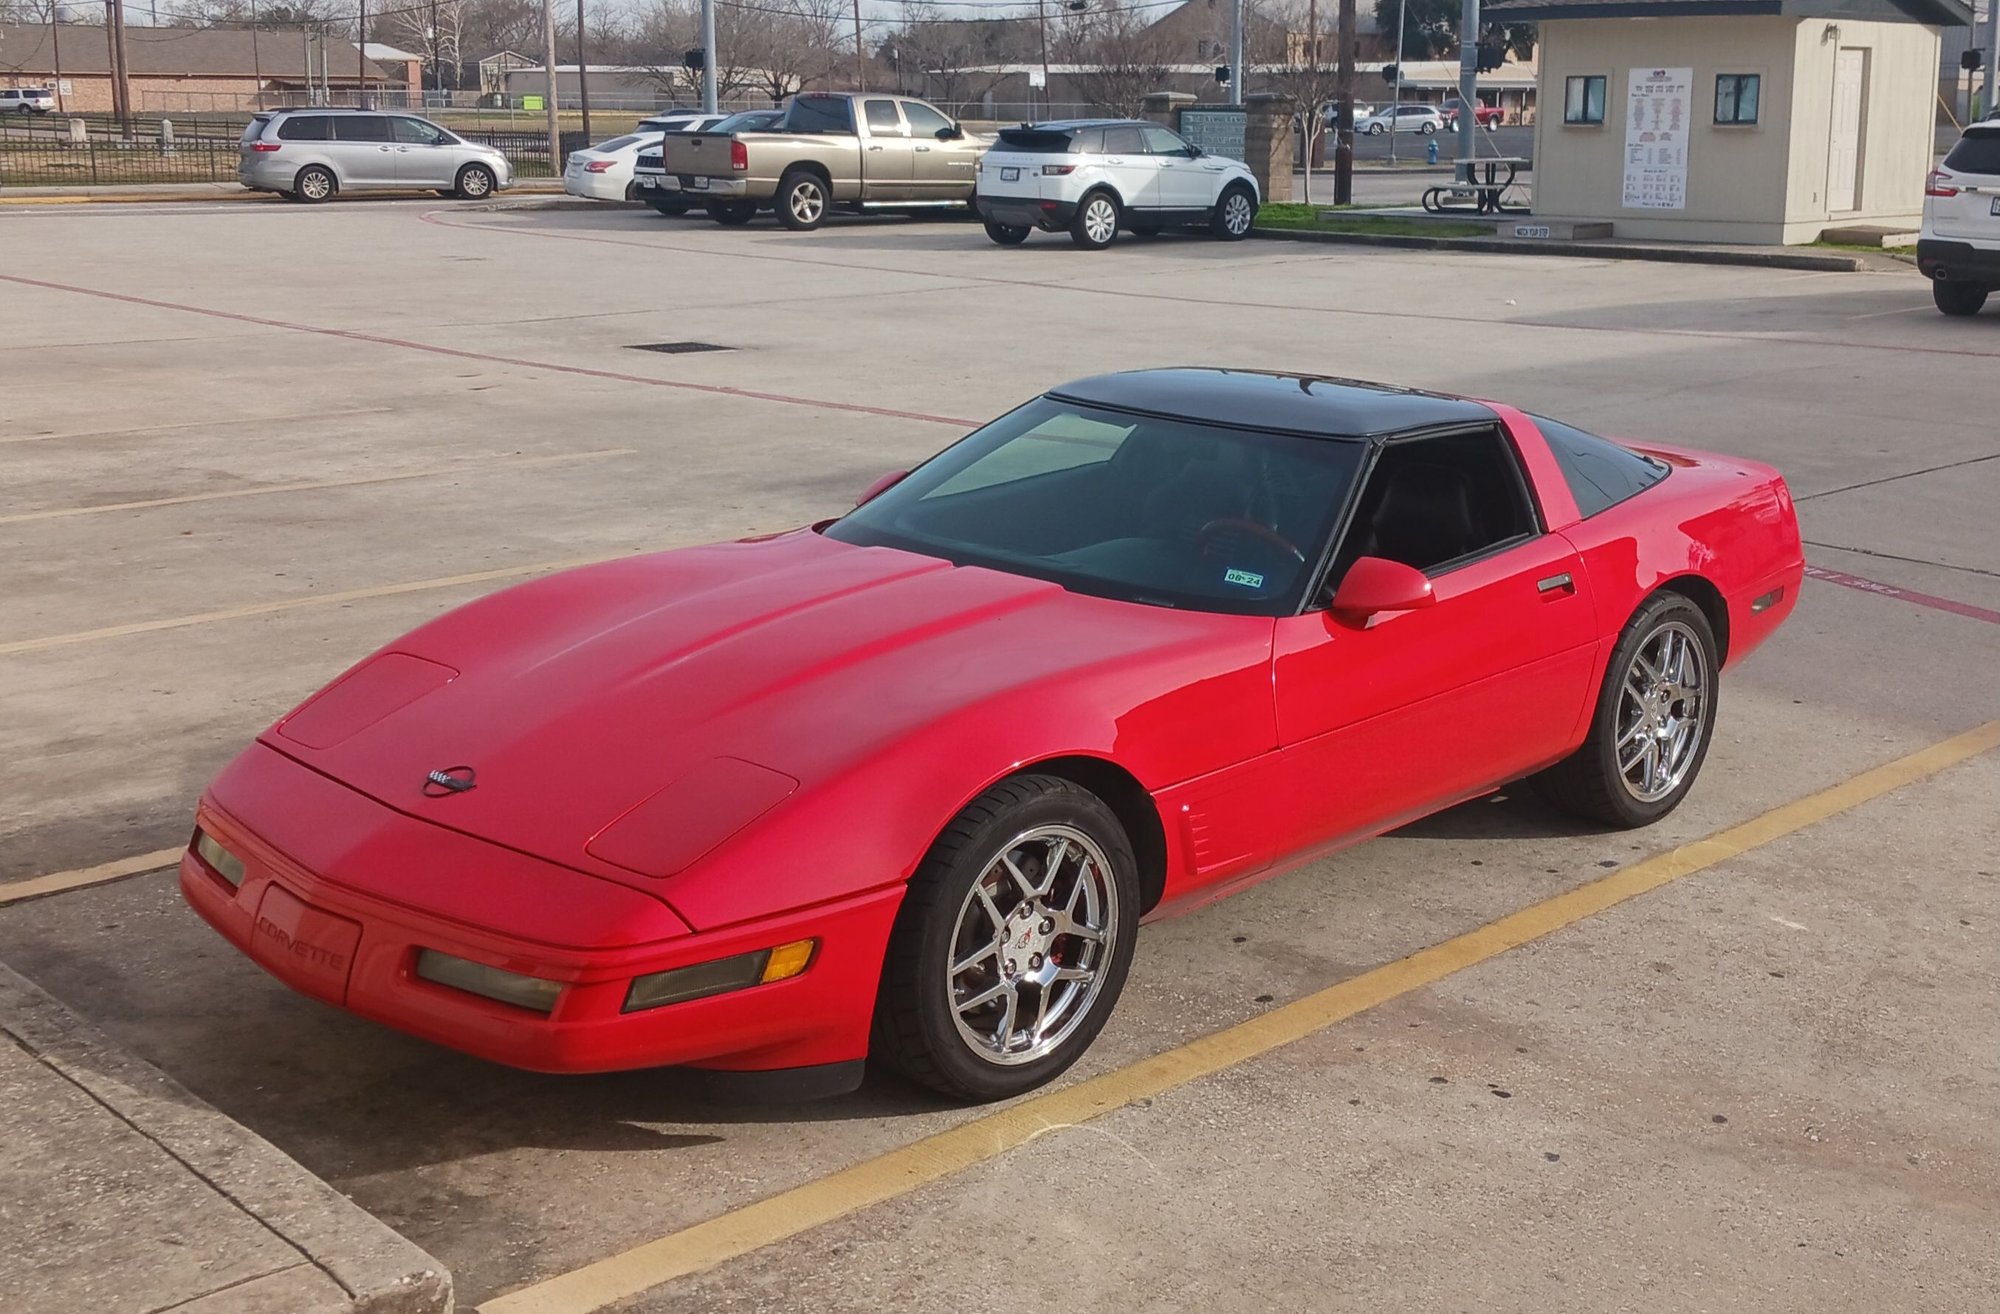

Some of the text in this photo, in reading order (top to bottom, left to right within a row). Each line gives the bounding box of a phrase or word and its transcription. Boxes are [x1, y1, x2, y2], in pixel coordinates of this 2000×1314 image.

[1529, 228, 1538, 237] YOUR
[1539, 228, 1548, 237] STEP
[258, 916, 344, 971] CORVETTE
